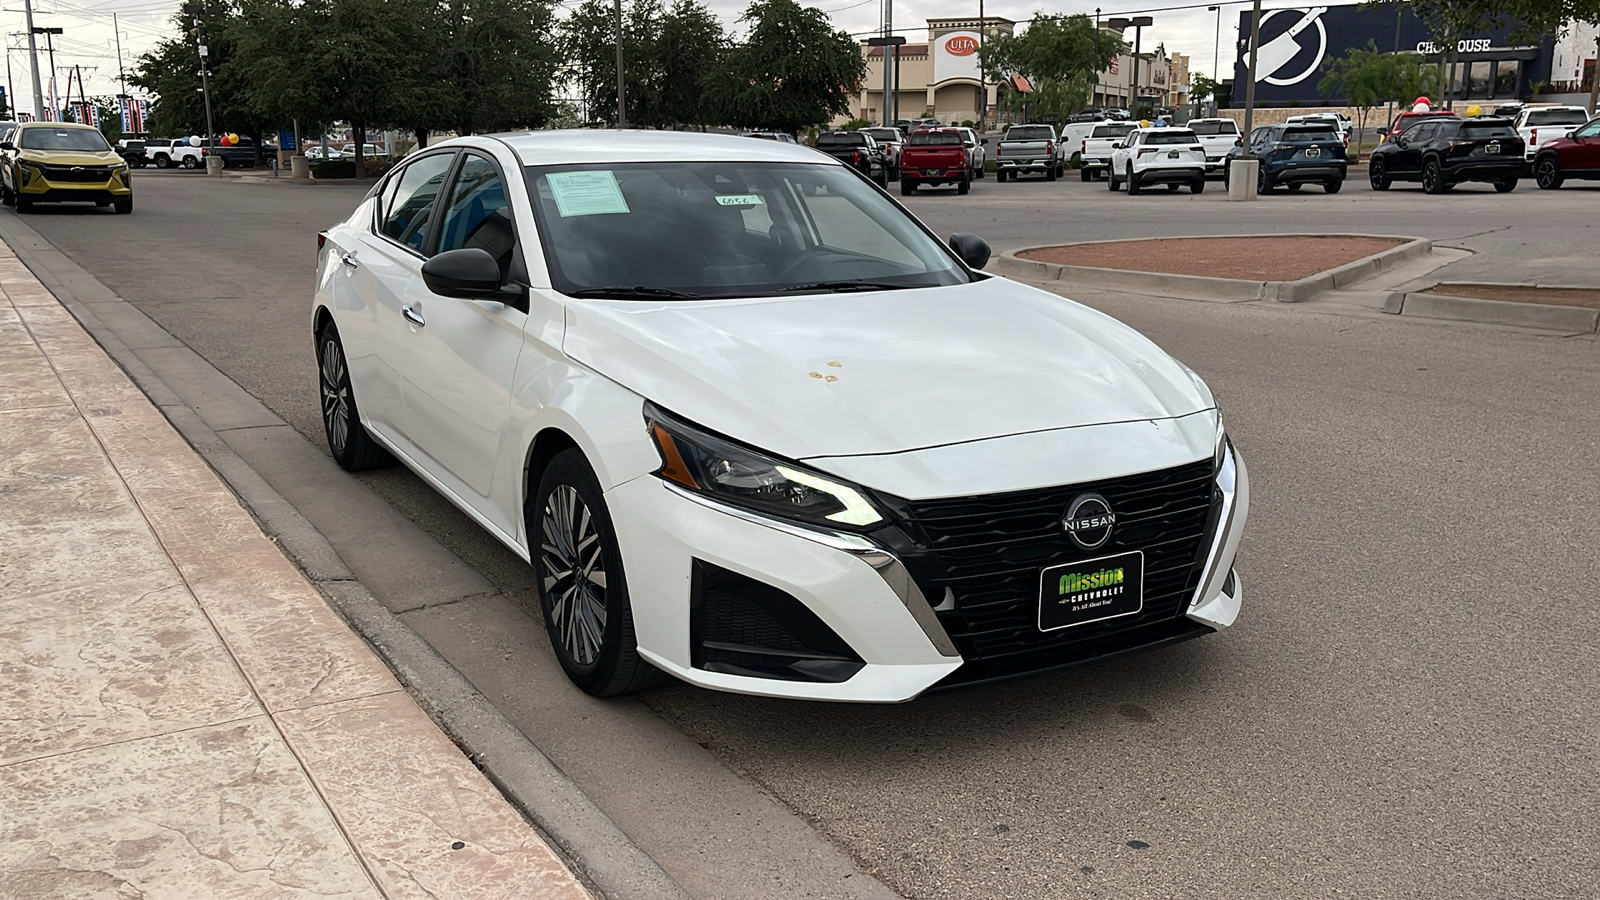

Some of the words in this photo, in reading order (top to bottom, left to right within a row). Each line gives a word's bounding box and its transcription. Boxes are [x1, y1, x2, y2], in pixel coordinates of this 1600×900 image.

[951, 40, 975, 49] ULTA
[1416, 39, 1491, 54] CHOOUSE
[1064, 514, 1116, 531] NISSAN
[1059, 567, 1124, 595] Mission
[1071, 586, 1124, 603] CHEVROLET
